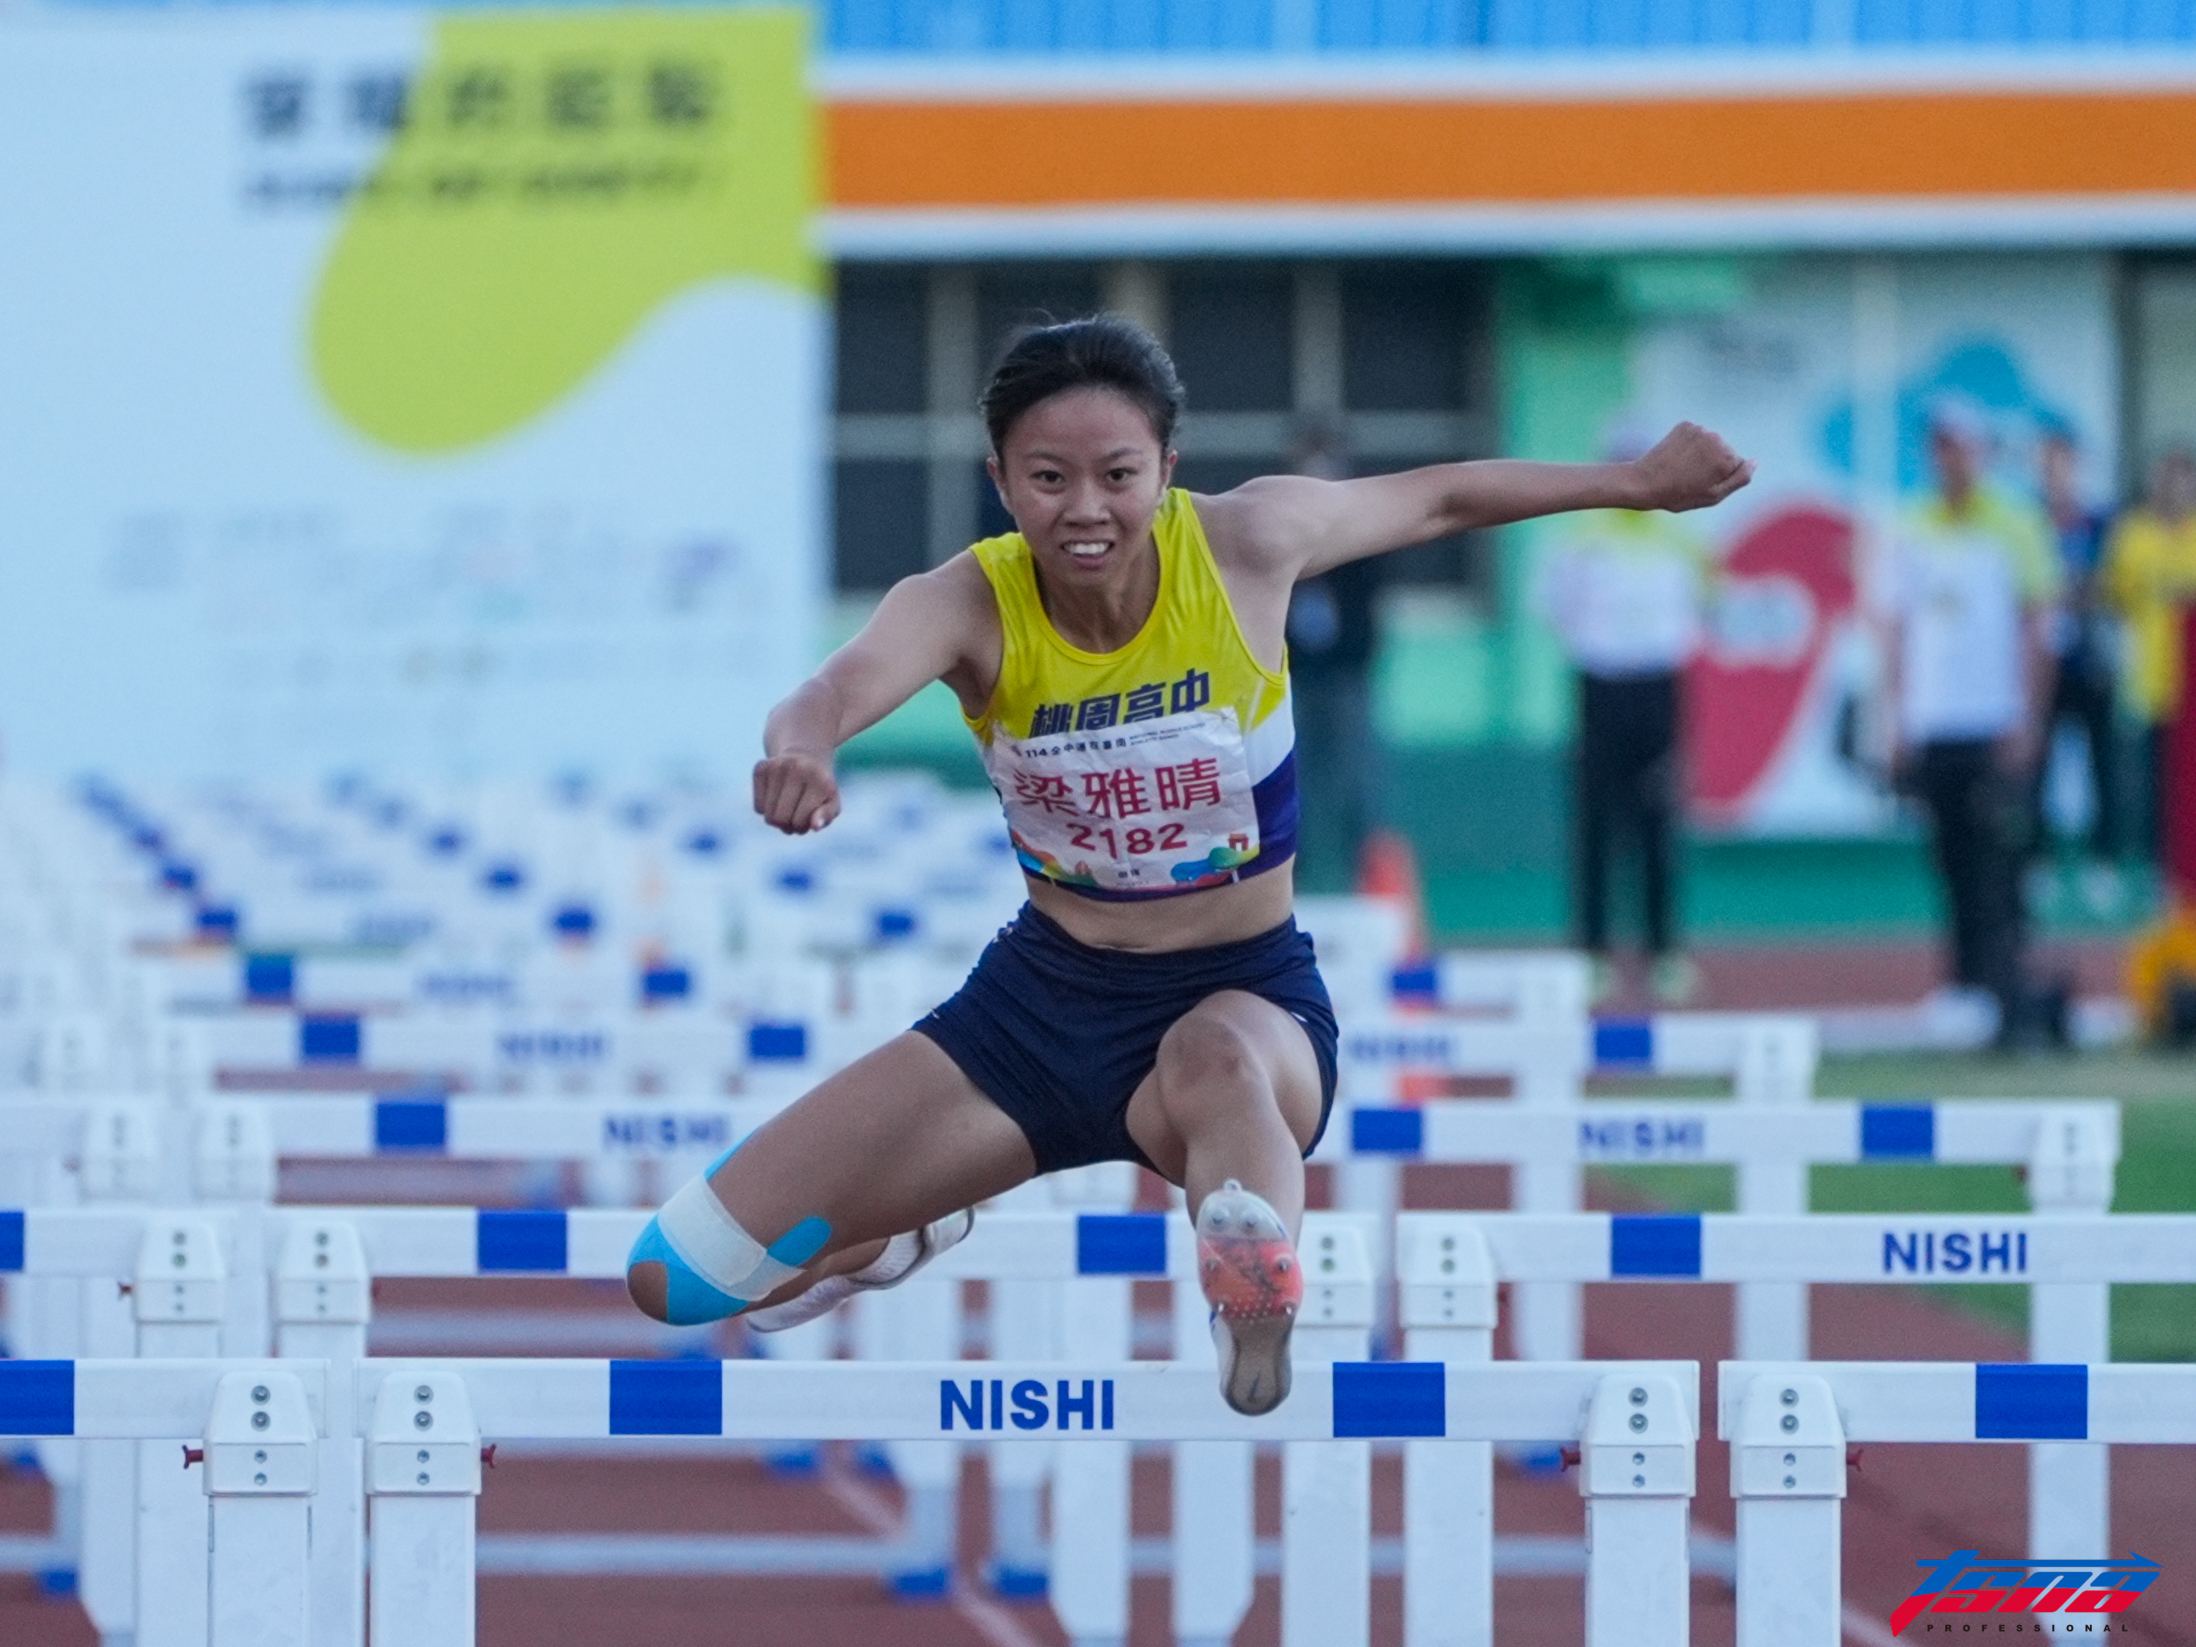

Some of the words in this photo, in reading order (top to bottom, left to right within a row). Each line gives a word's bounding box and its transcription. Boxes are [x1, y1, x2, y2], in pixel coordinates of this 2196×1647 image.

[1013, 758, 1221, 819] 梁雅晴
[1066, 823, 1188, 859] 2182
[1883, 1232, 2028, 1274] NISHI
[940, 1379, 1114, 1431] NISHI
